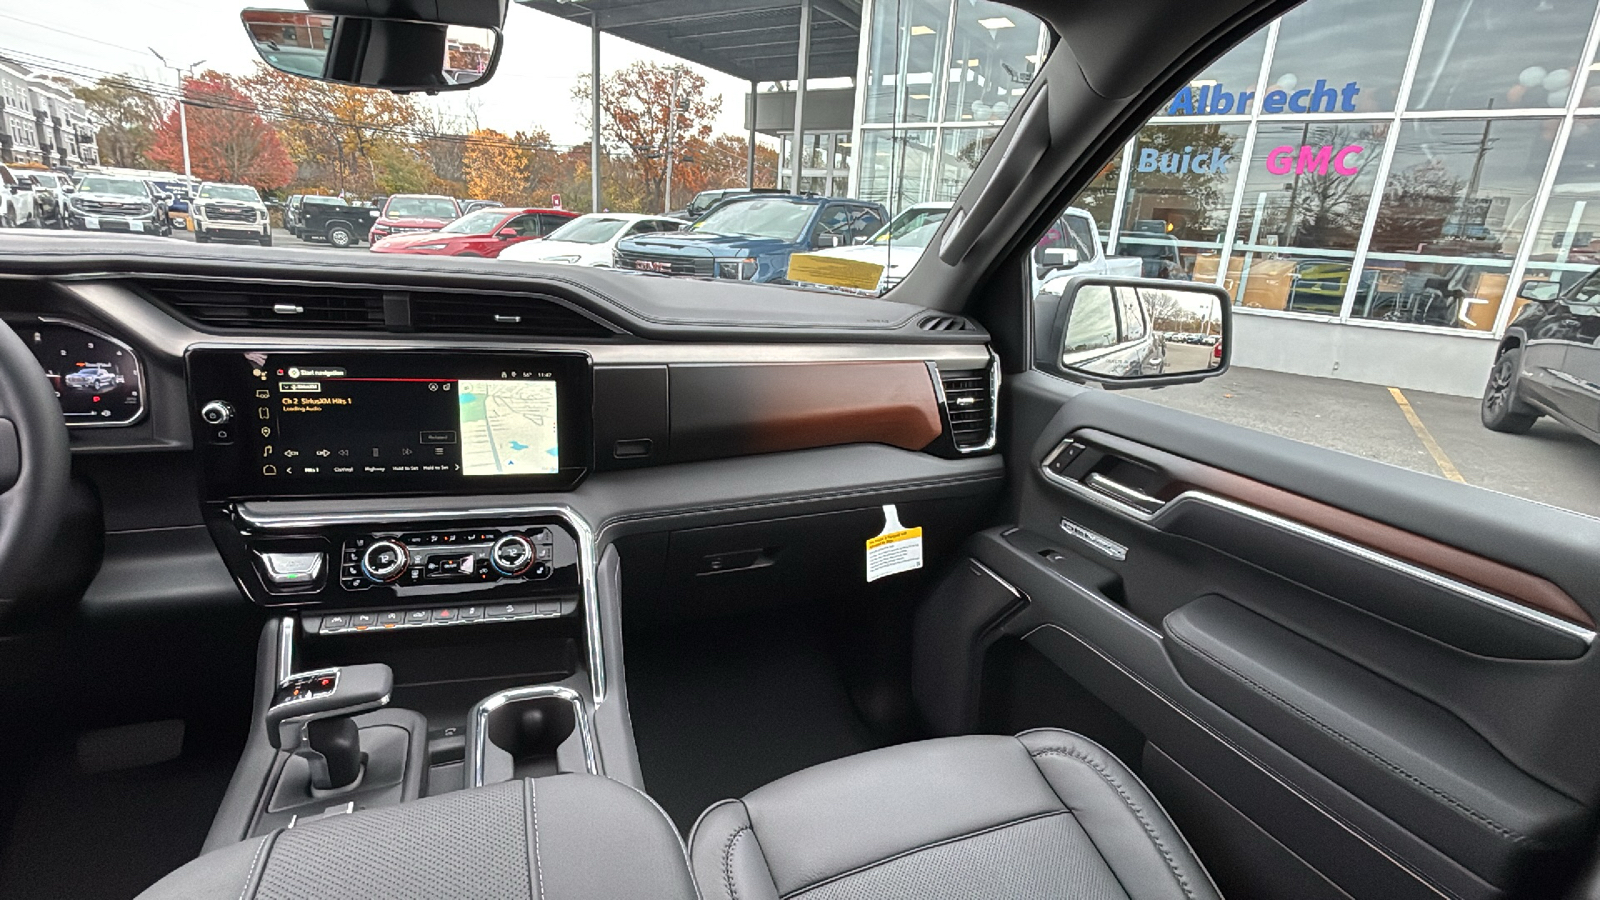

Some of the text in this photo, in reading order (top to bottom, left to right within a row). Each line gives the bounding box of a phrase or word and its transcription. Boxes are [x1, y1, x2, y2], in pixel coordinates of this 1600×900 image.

[1167, 79, 1360, 116] Albrecht
[1138, 144, 1364, 176] Buick GMC
[634, 259, 672, 273] GMC
[301, 397, 331, 405] SiriusXM
[332, 397, 347, 405] Hits
